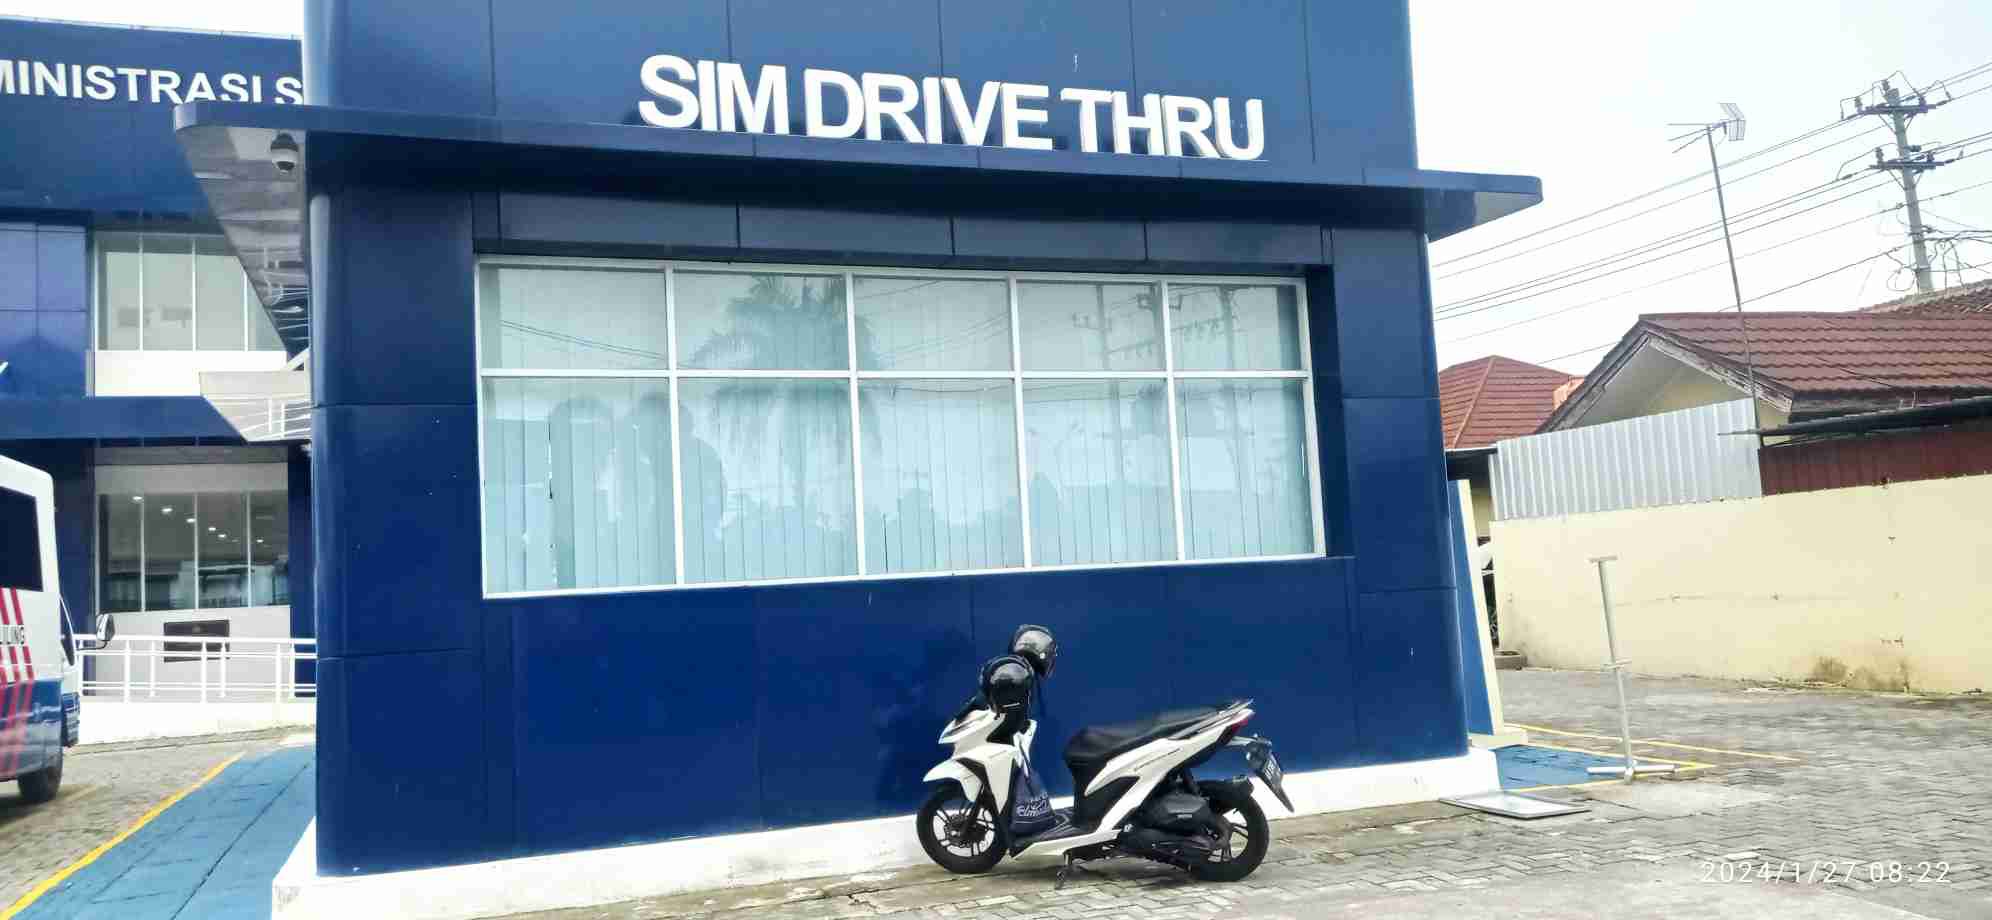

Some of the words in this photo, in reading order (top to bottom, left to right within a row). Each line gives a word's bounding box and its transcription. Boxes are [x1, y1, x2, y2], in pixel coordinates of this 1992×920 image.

[638, 54, 789, 135] SIM
[803, 67, 1053, 151] DRIVE
[1059, 87, 1265, 161] THRU
